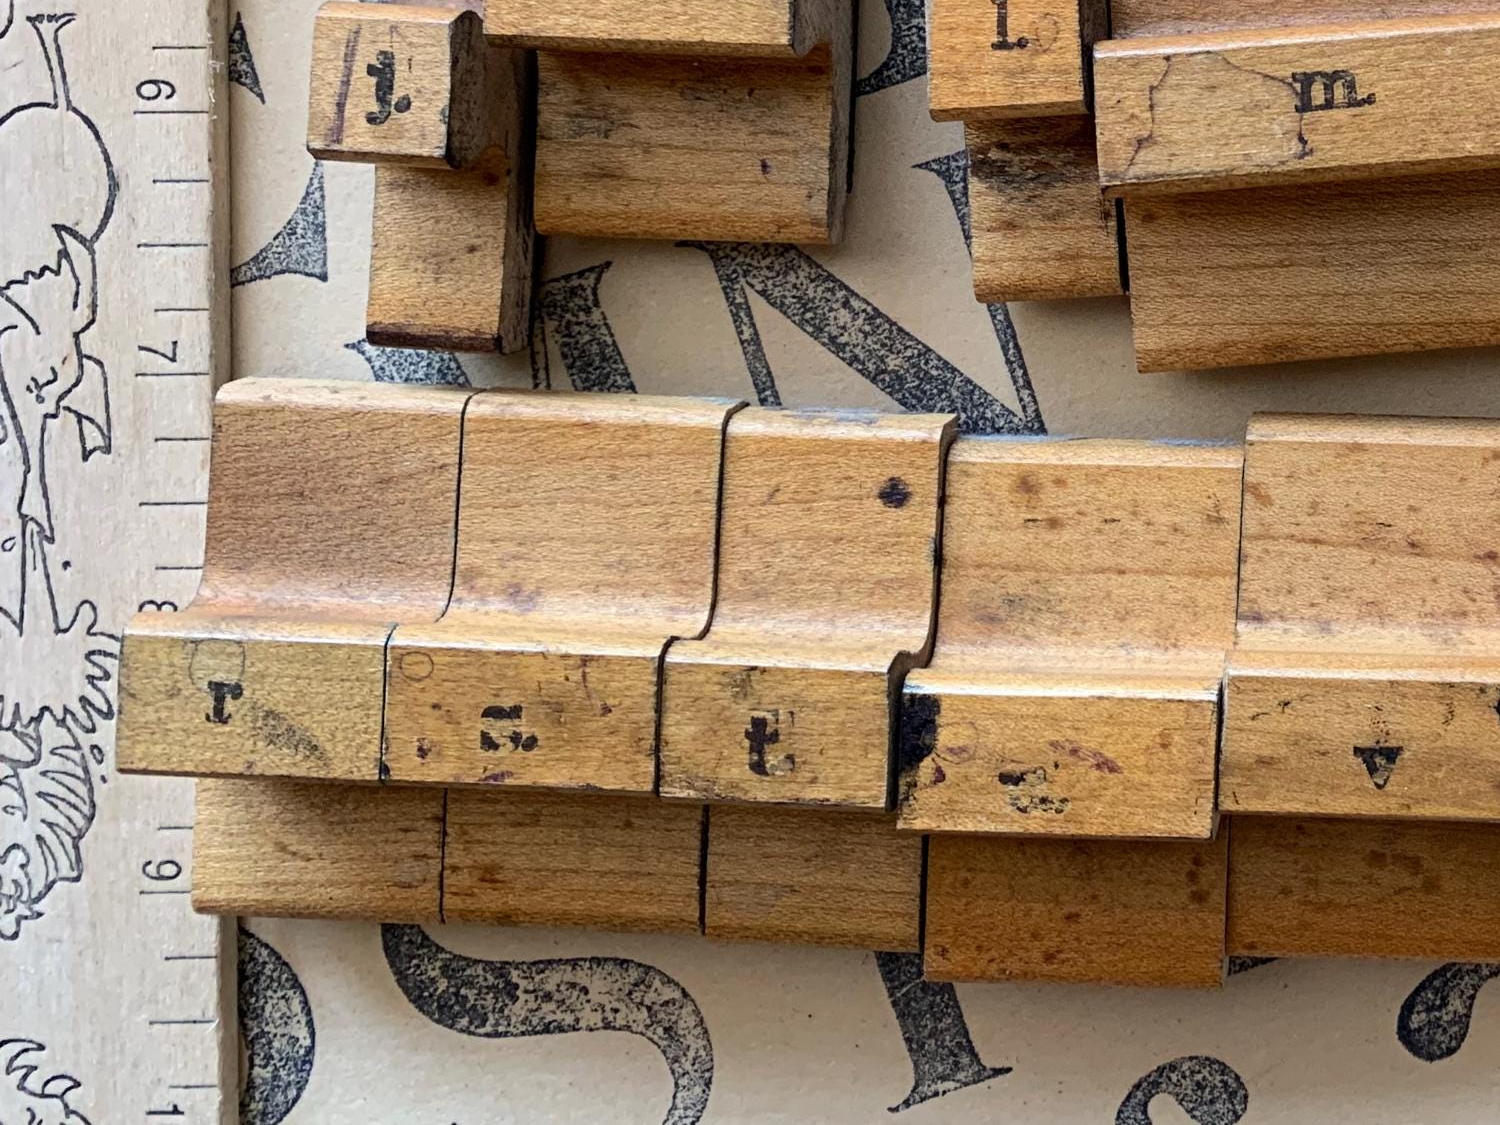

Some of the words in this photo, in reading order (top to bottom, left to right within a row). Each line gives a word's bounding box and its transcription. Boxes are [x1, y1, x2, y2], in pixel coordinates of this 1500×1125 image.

[135, 79, 176, 102] 6
[1291, 69, 1377, 113] m.
[136, 339, 179, 364] 7
[141, 858, 184, 883] 9
